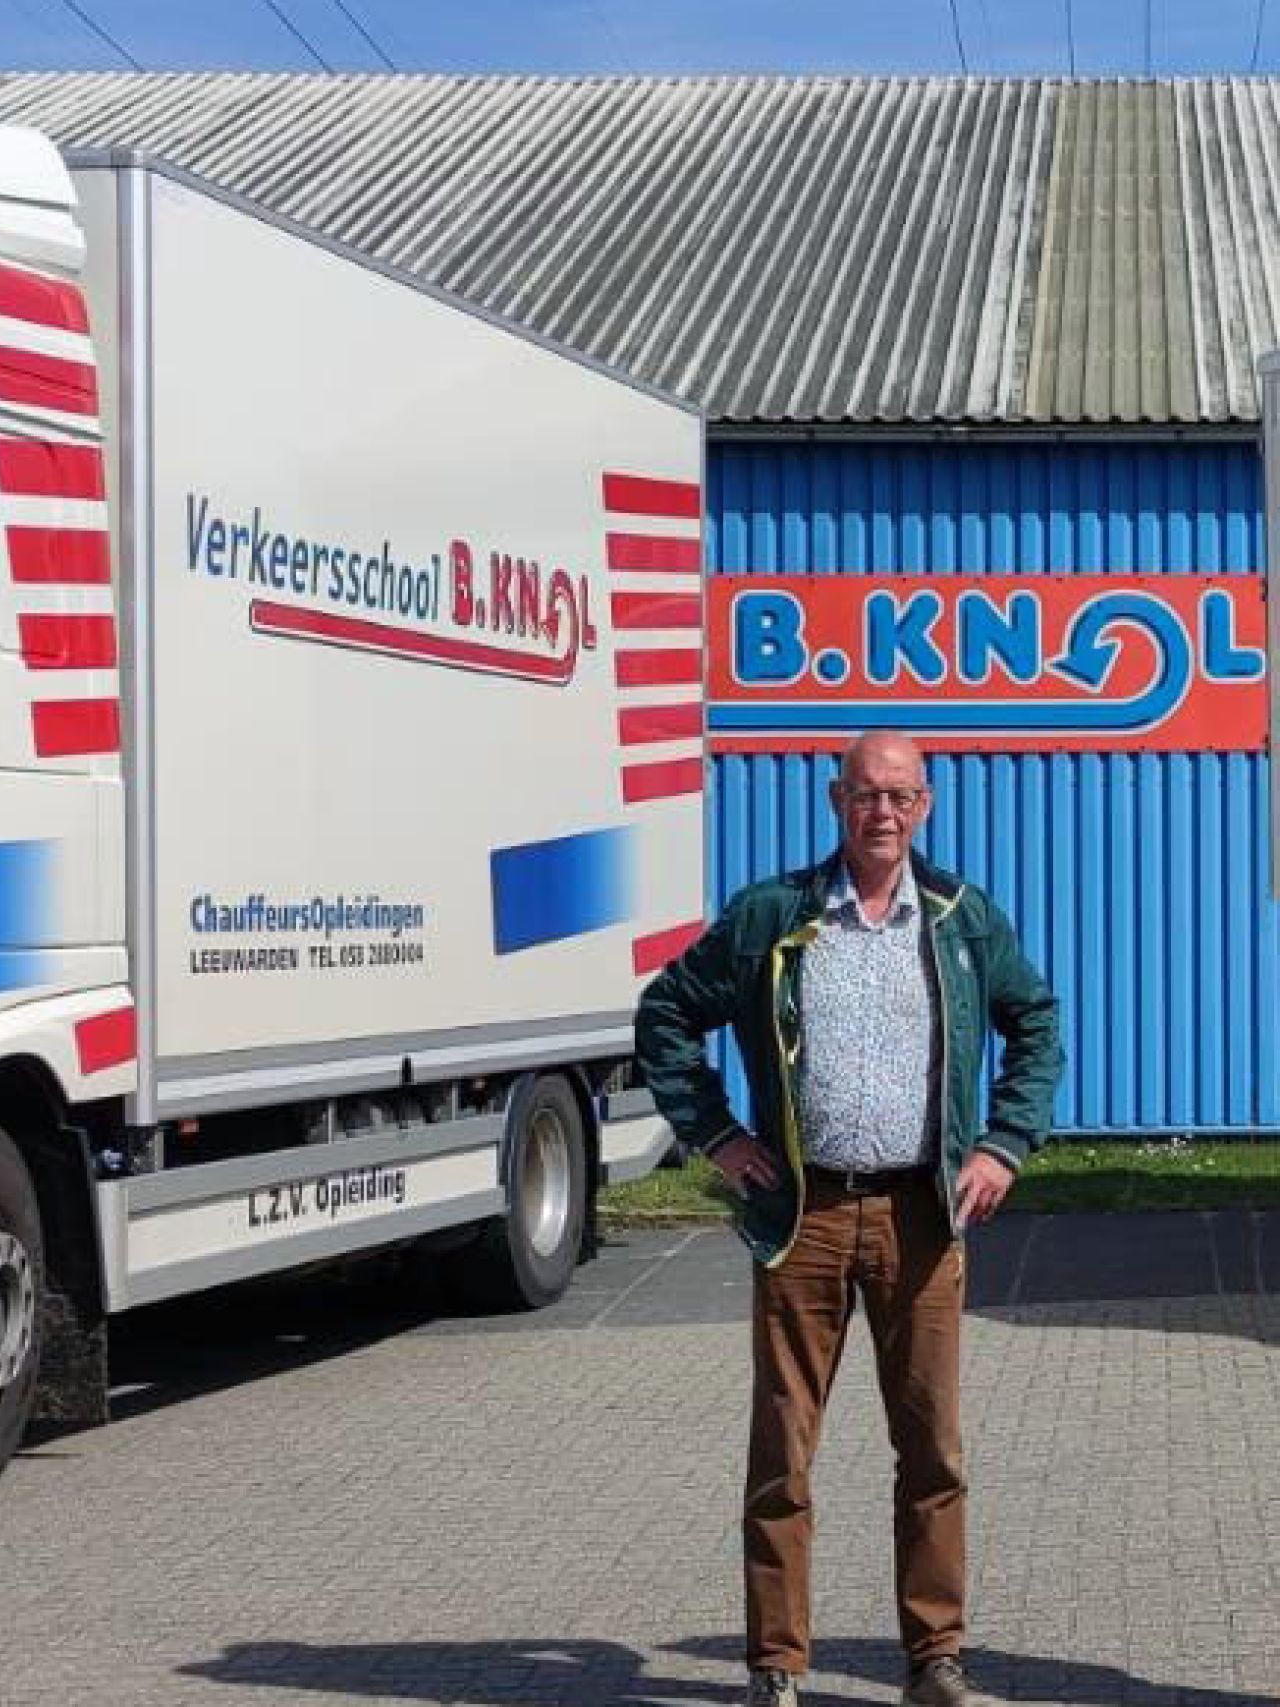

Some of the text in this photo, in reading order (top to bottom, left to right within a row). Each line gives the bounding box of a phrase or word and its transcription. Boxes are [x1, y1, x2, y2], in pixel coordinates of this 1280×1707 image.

[186, 492, 440, 622] Verkeersschool
[190, 894, 424, 939] ChauffeursOpleidingen
[190, 948, 299, 974] LEEUWARDEN
[317, 1168, 405, 1219] Opleiding
